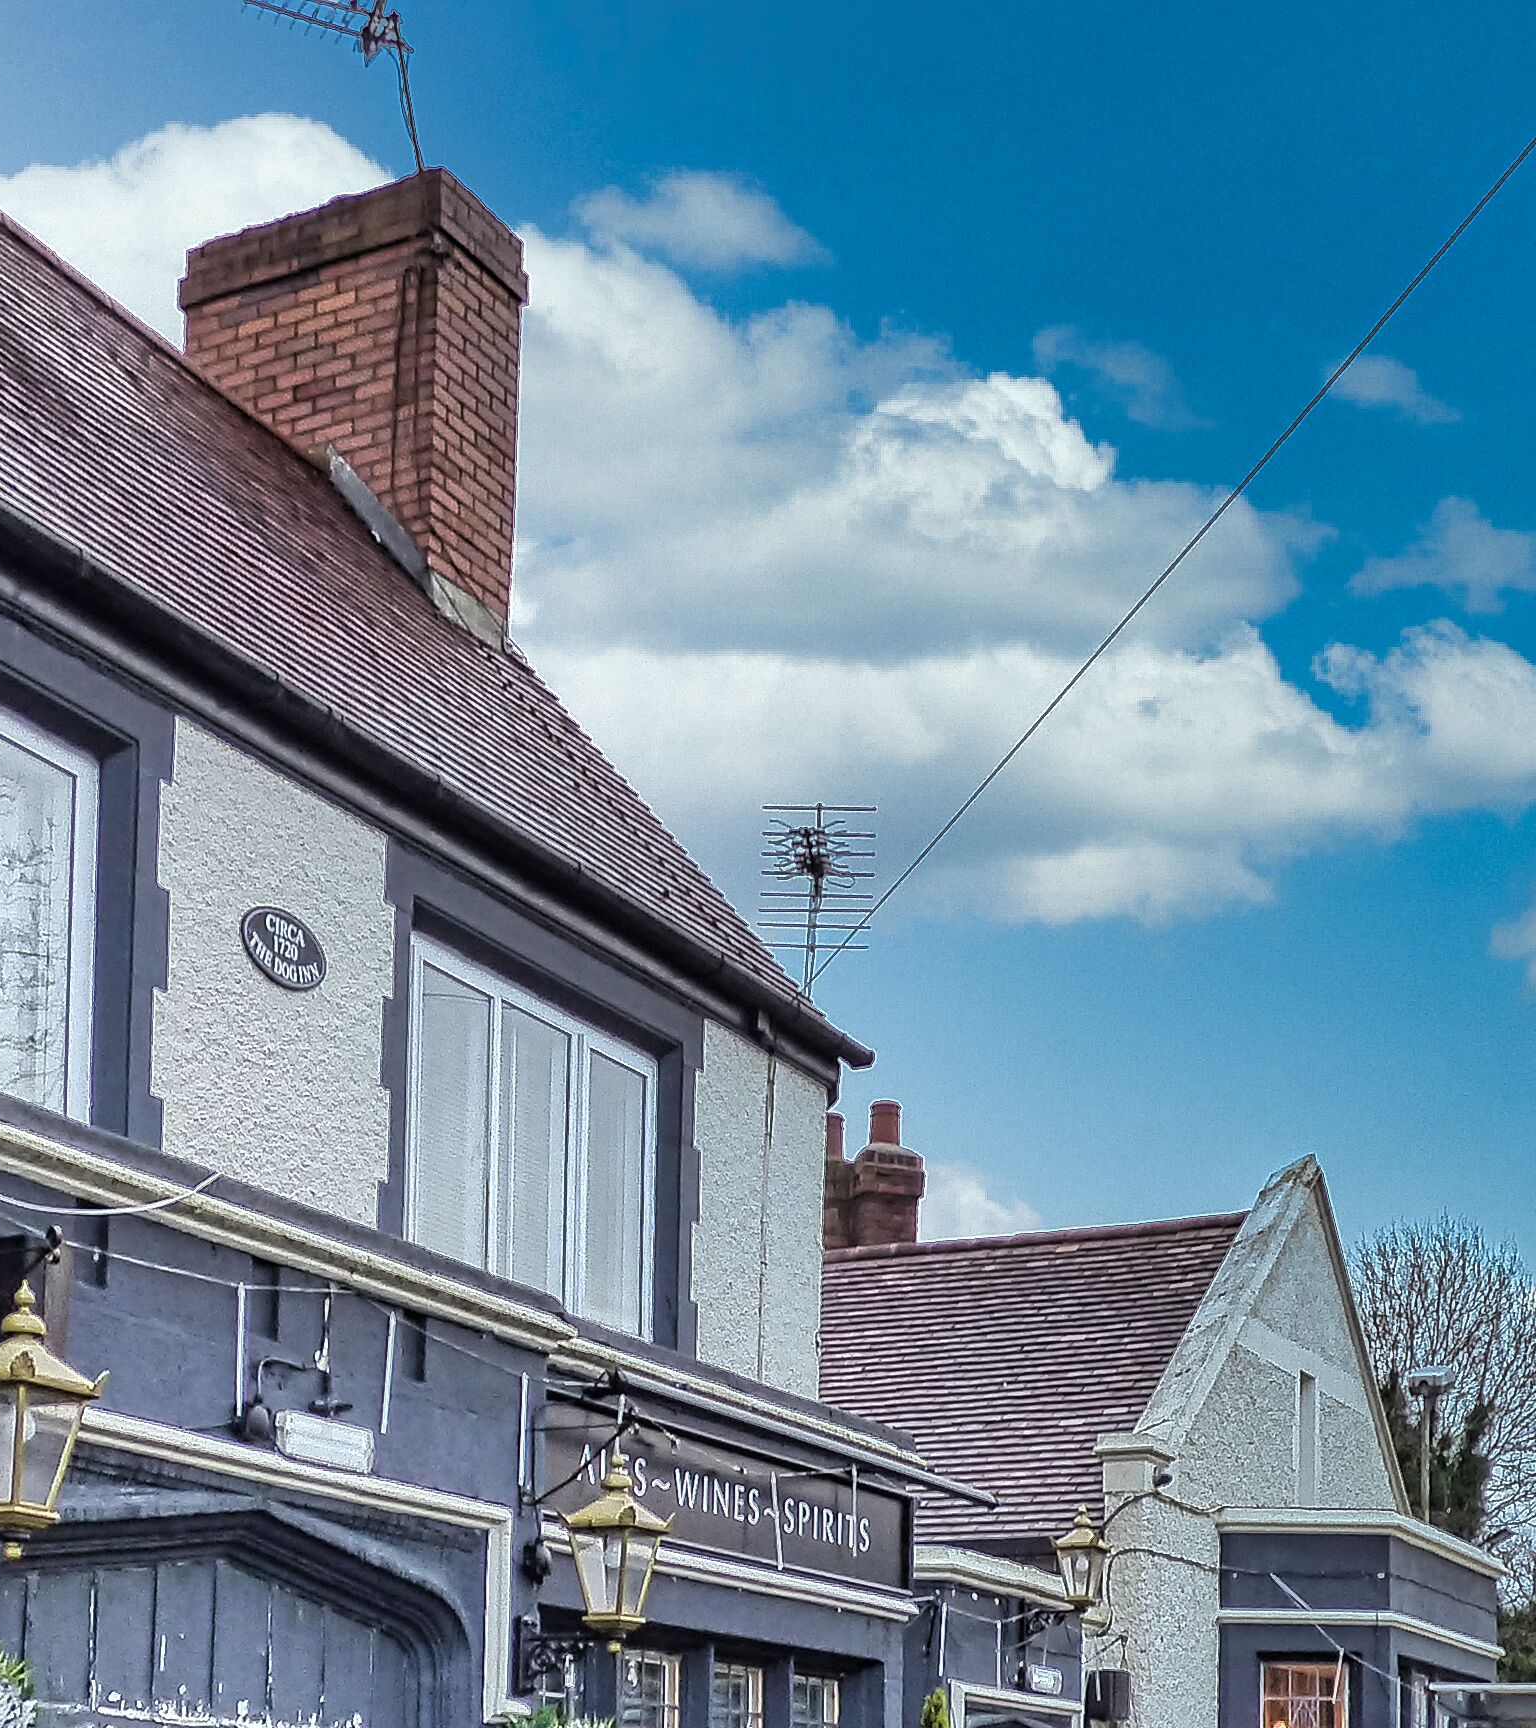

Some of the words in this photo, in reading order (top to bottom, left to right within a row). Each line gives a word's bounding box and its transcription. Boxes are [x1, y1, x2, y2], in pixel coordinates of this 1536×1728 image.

[265, 913, 306, 948] CIRCA
[273, 935, 299, 961] 1720
[249, 931, 273, 967] THE
[274, 957, 298, 983] DOG
[297, 962, 320, 984] INN
[783, 1497, 871, 1552] SPIRITS
